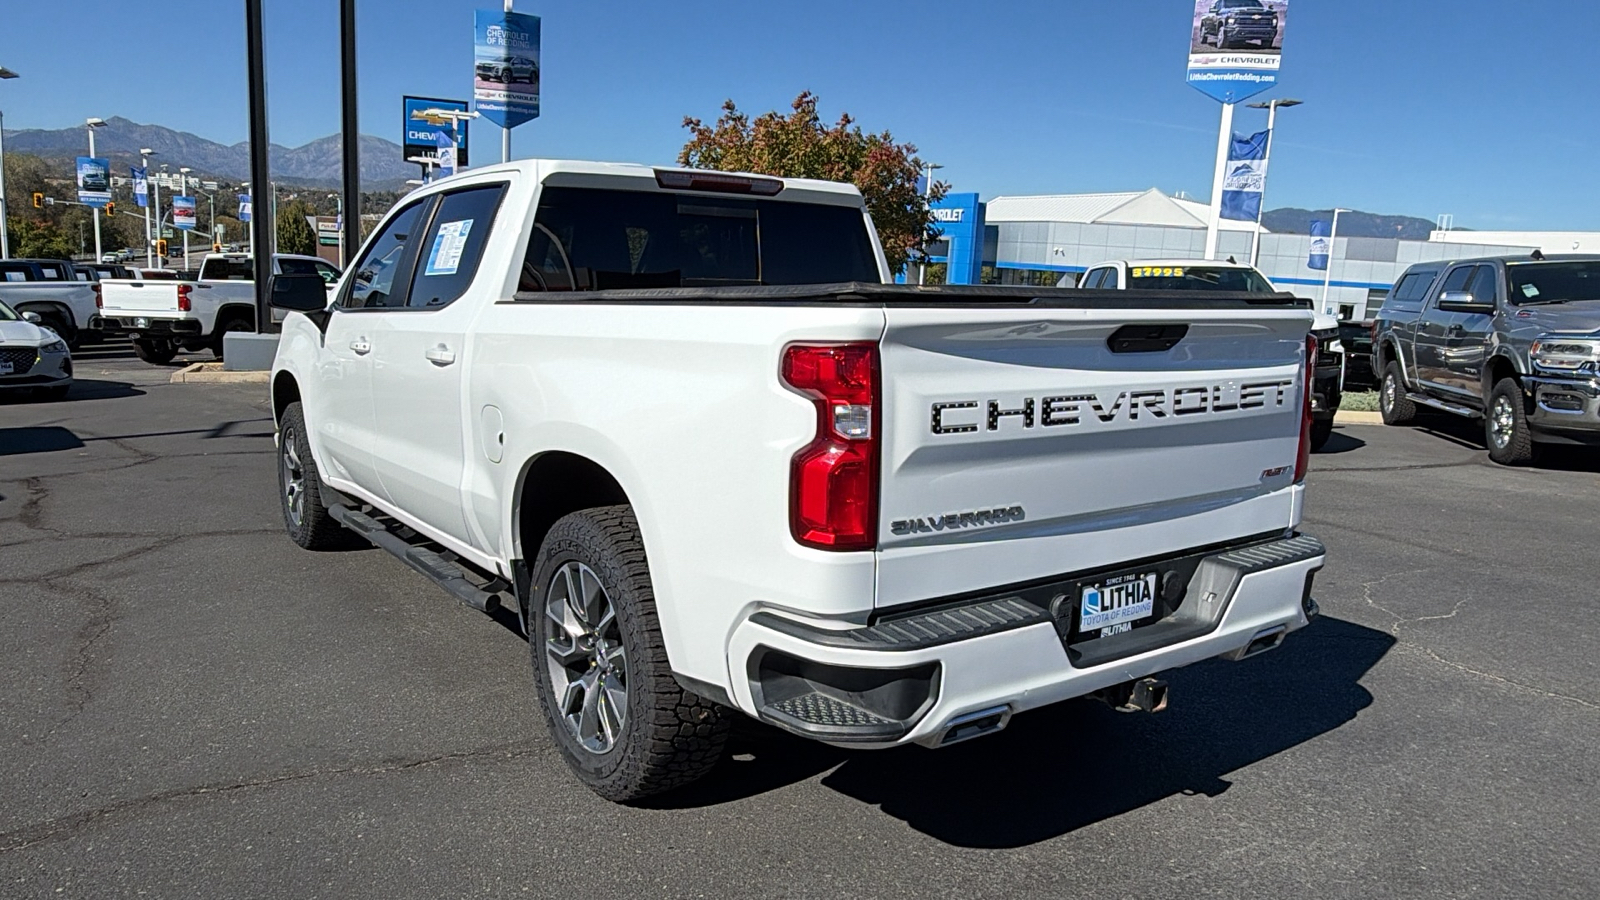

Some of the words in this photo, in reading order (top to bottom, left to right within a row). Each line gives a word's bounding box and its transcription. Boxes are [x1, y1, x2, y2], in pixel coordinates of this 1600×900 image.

[486, 28, 529, 41] CHEVROLET
[486, 36, 497, 45] OF
[498, 37, 530, 49] REDDING
[1220, 56, 1277, 65] CHEVROLET
[1189, 72, 1276, 83] LithiaChevroletRedding.com
[498, 92, 538, 102] CHEVROLET
[1132, 267, 1184, 278] 37995
[930, 378, 1293, 436] CHEVROLET
[890, 503, 1026, 536] SILVERADO
[1106, 577, 1122, 585] SINCE
[1100, 580, 1151, 612] LITHIA
[1082, 612, 1110, 626] TOYOTA
[1111, 611, 1119, 619] OF
[1122, 602, 1151, 617] REDDING
[1109, 622, 1132, 634] LITHIA
